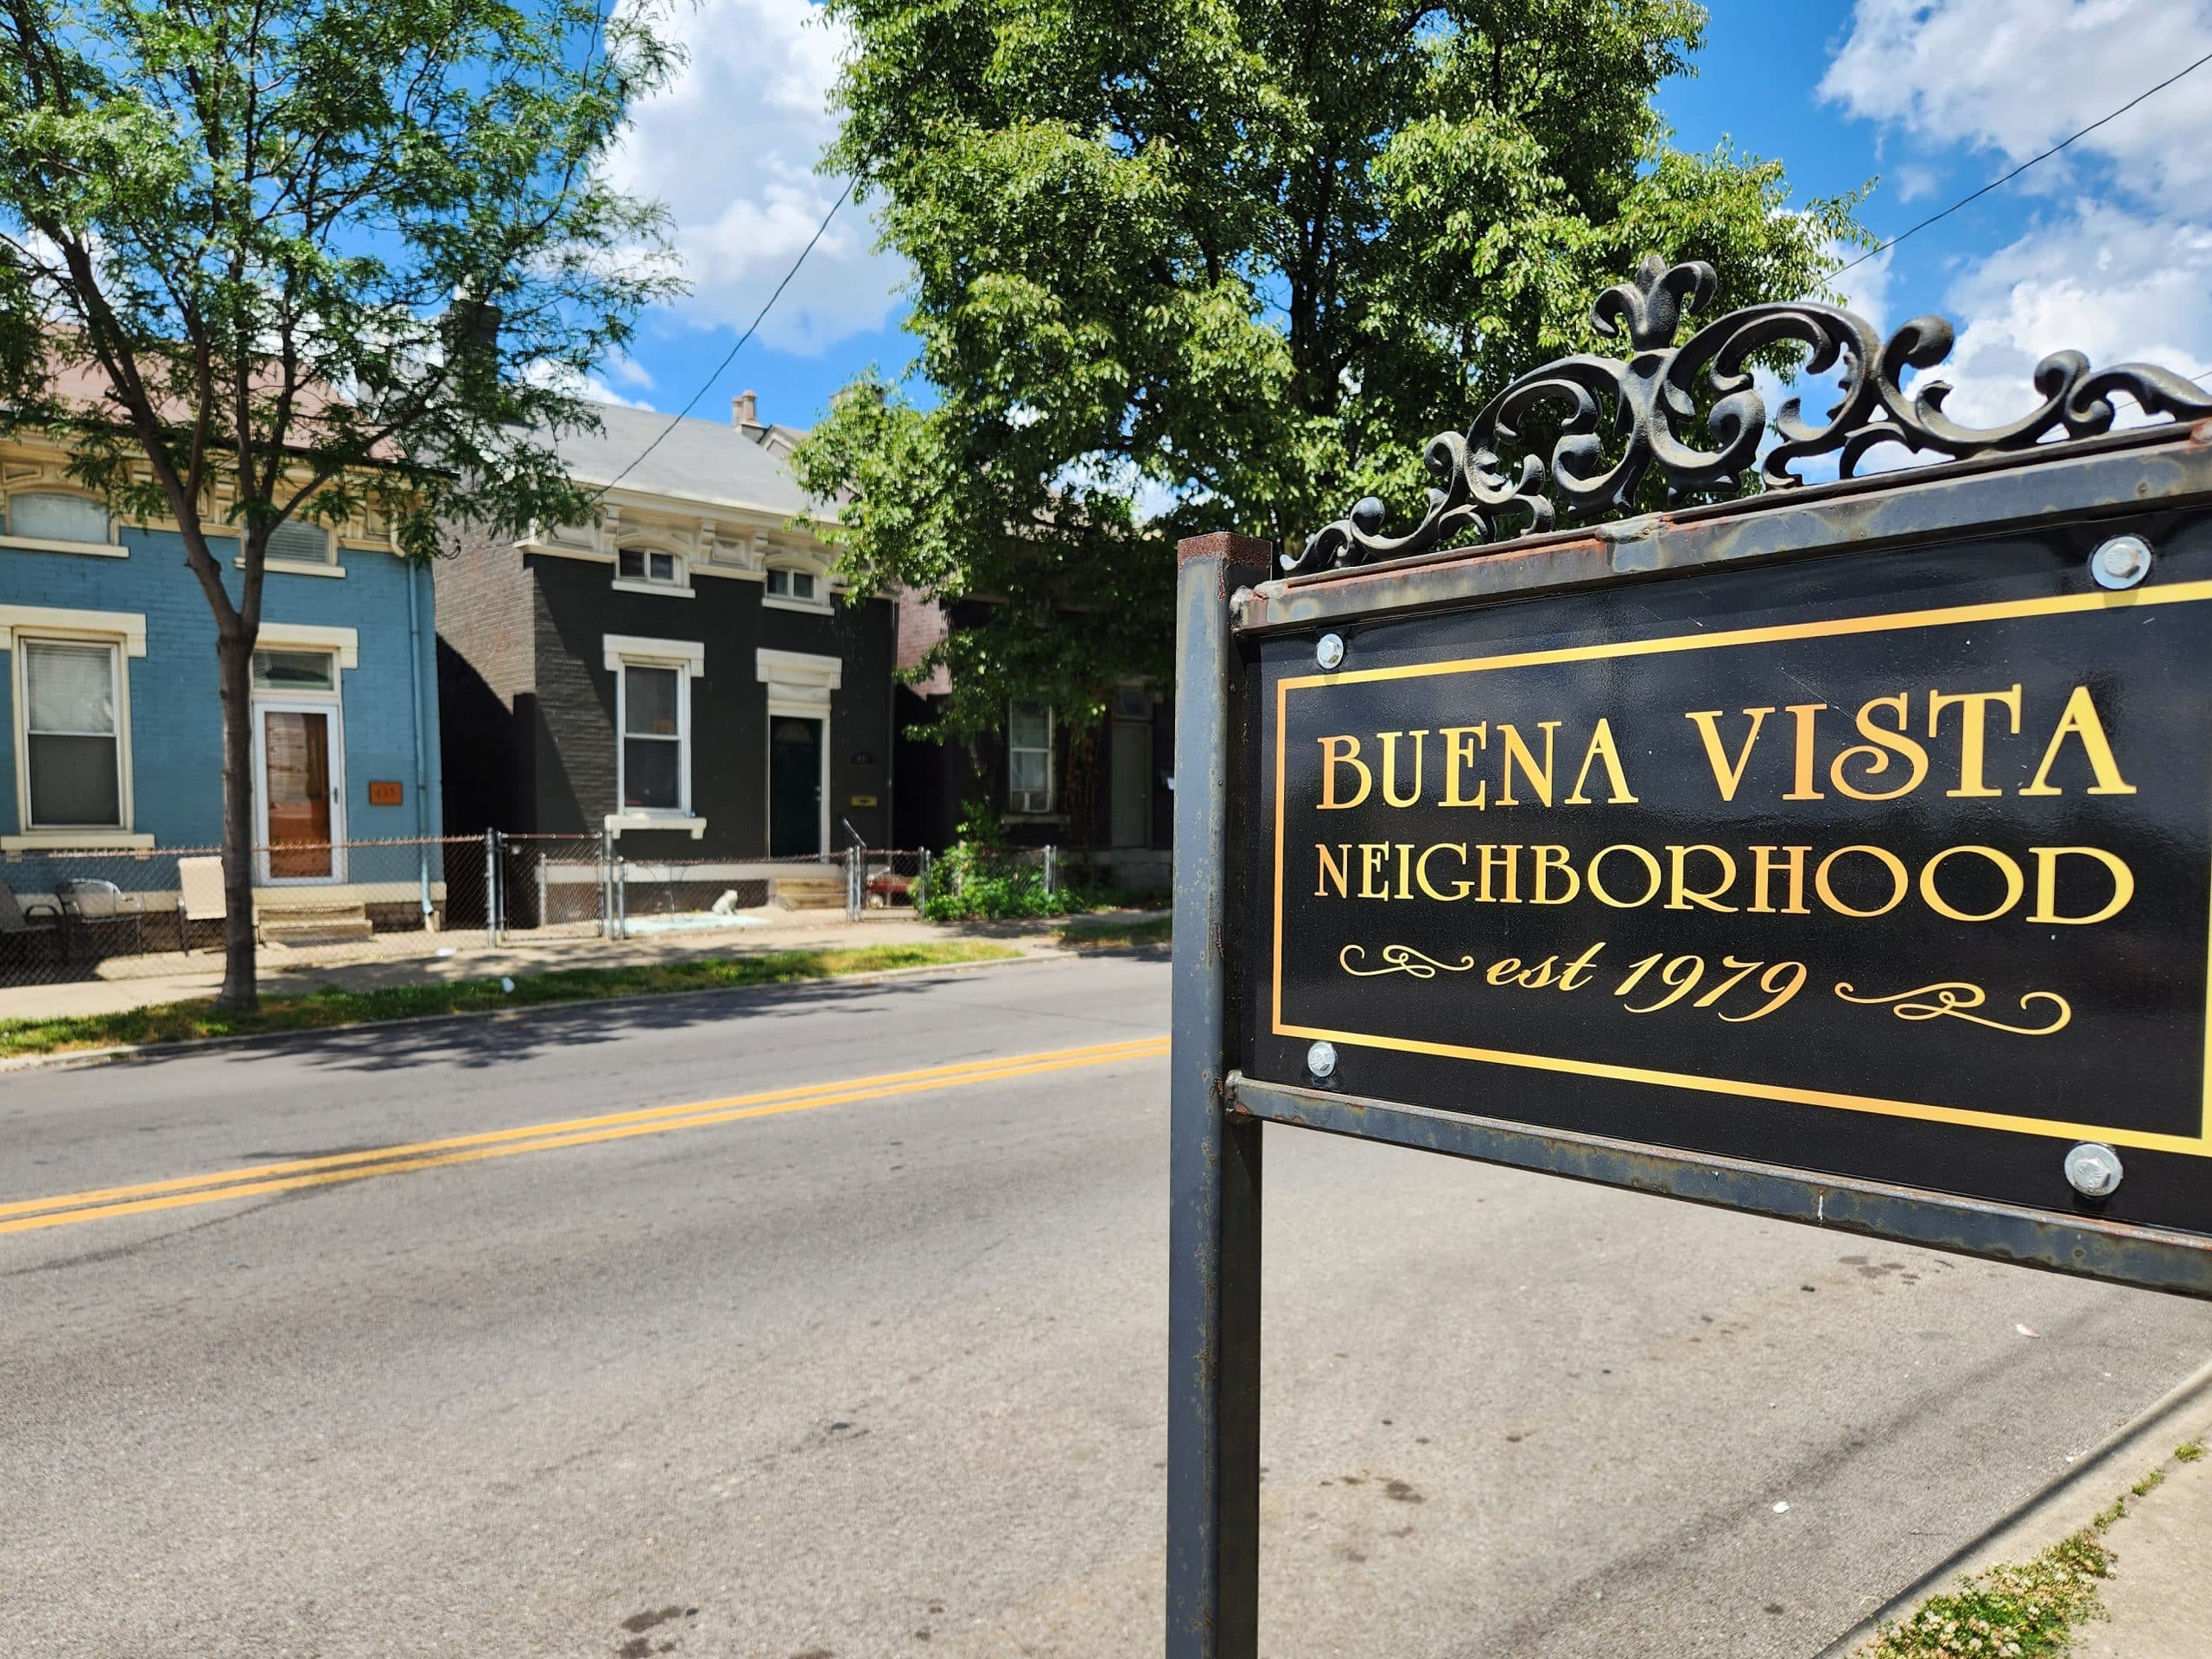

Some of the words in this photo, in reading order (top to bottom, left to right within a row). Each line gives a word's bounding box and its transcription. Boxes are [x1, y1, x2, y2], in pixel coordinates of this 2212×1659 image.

[1316, 718, 1638, 810] BUENA
[1685, 683, 2137, 801] VISTA
[1314, 841, 2136, 925] NEIGHBORHOOD
[1486, 941, 1606, 991] est
[1613, 952, 1808, 1022] 1979
